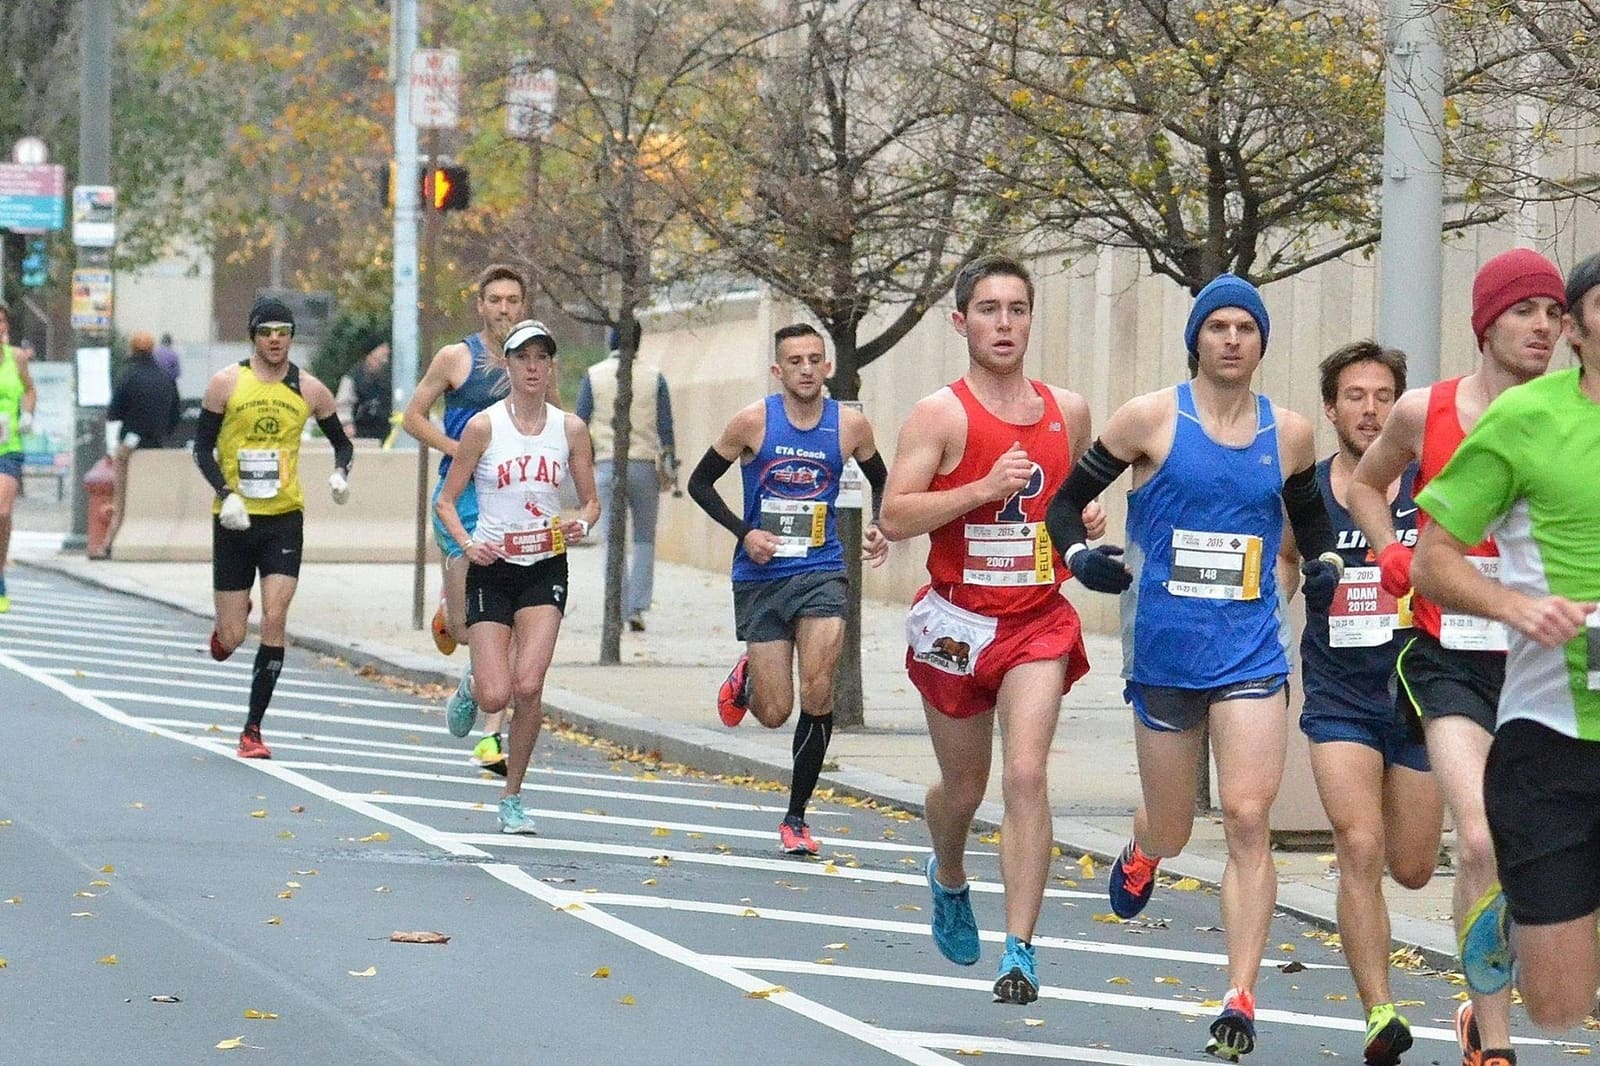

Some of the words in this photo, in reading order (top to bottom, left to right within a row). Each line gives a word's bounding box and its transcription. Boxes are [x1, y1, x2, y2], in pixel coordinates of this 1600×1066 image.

[775, 445, 794, 456] ETA
[796, 448, 826, 459] Coach
[780, 515, 795, 526] PAT
[997, 527, 1015, 537] 2015
[1206, 537, 1224, 548] 2015
[1039, 535, 1049, 572] ELITE
[986, 557, 1015, 568] 20071
[1199, 568, 1218, 580] 148
[1356, 570, 1374, 580] 2015
[1346, 587, 1378, 600] ADAM
